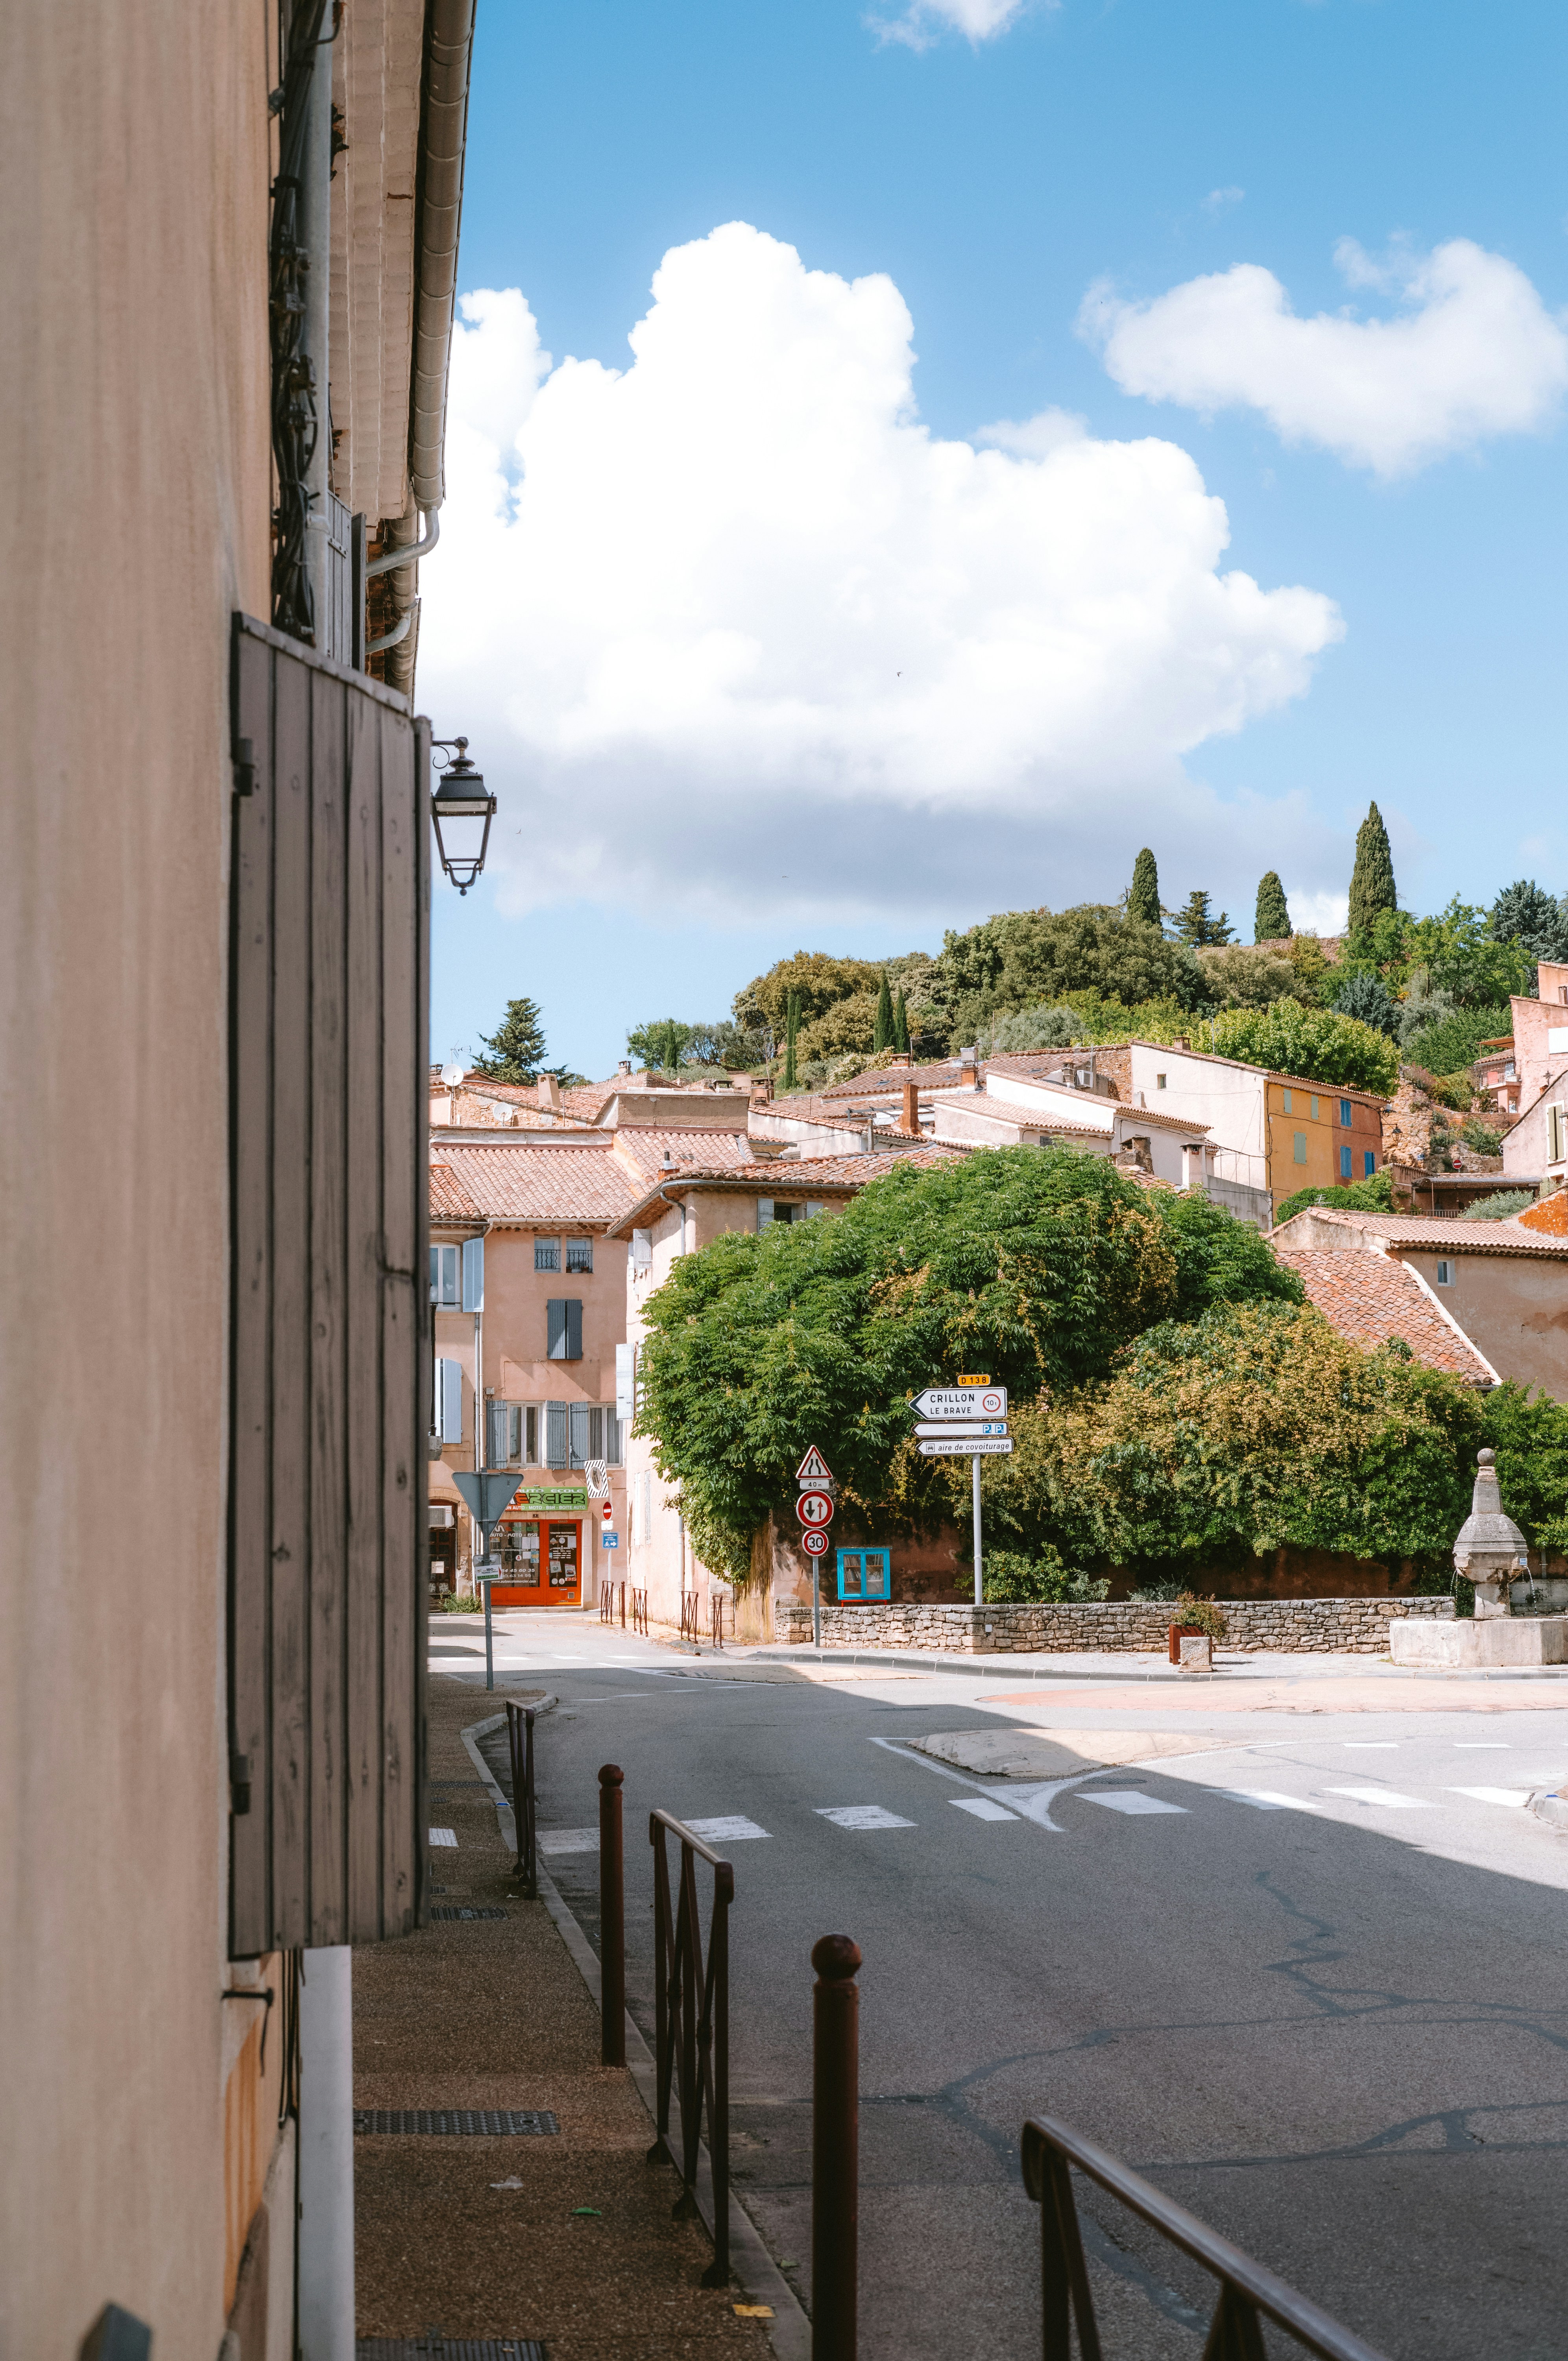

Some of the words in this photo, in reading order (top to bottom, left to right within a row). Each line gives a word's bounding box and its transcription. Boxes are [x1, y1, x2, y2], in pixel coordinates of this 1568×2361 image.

[930, 1394, 975, 1403] CRILLON
[966, 1443, 1009, 1451] covoiturage
[510, 1493, 585, 1505] ERCIER
[809, 1537, 824, 1548] 30
